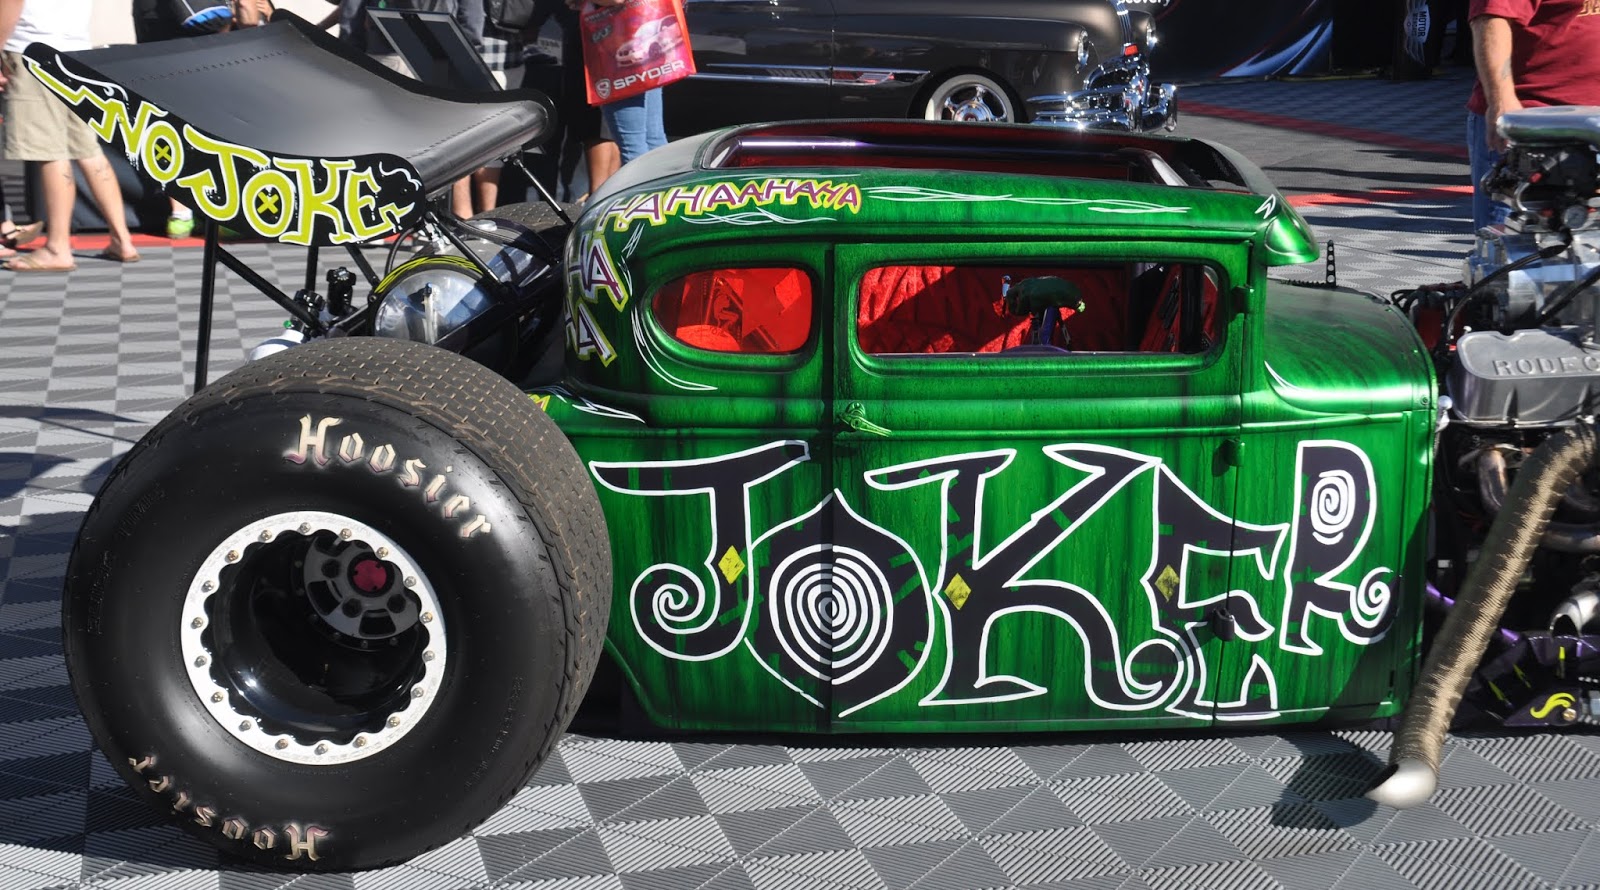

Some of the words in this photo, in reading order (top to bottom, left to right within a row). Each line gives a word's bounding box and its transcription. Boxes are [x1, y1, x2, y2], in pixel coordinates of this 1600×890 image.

[613, 60, 685, 90] SPYDER
[1418, 11, 1427, 37] MOTOR
[86, 97, 184, 182] NO
[177, 124, 414, 246] JOKE
[284, 413, 492, 538] Hoosier
[589, 440, 1396, 721] JOKER
[129, 756, 330, 862] Hoosier
